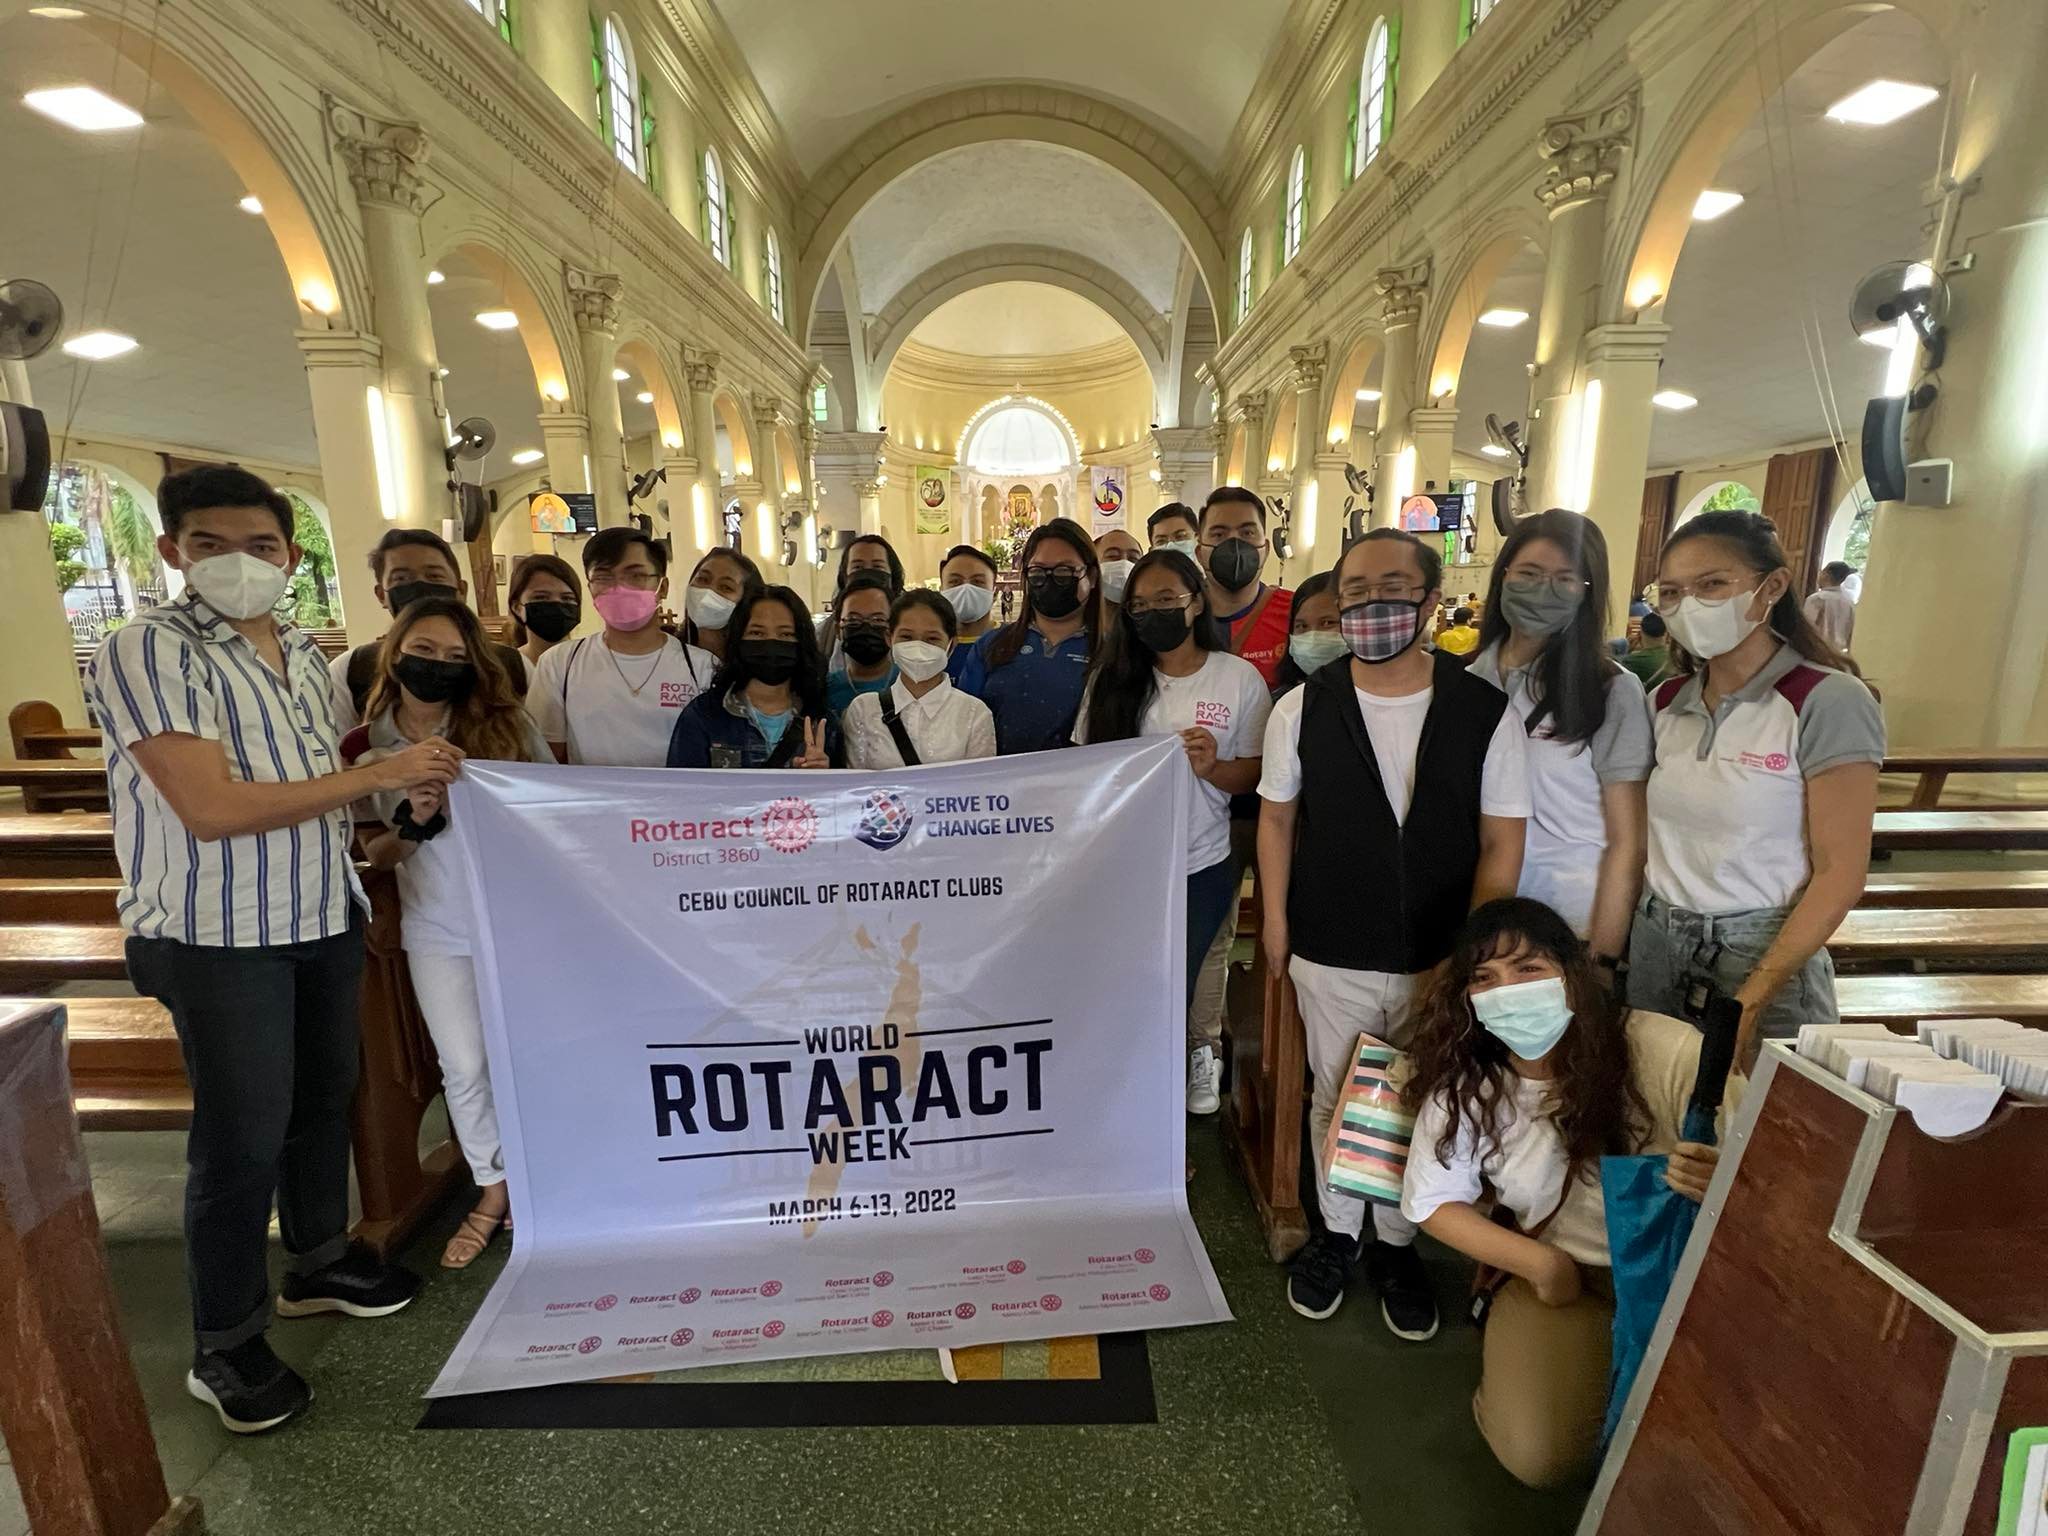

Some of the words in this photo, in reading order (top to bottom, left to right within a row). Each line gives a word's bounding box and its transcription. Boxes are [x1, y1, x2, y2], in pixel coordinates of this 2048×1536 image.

[1242, 650, 1273, 659] Rotary
[660, 682, 695, 693] ROTA
[1197, 701, 1231, 714] ROTA
[1196, 710, 1230, 723] RACT
[925, 796, 980, 814] SERVE
[986, 795, 1009, 811] TO
[631, 816, 754, 843] Rotaract
[927, 819, 1001, 836] CHANGE
[1006, 816, 1054, 834] LIVES
[653, 852, 710, 868] District
[718, 848, 760, 864] 3860
[680, 892, 727, 912] CEBU
[734, 886, 811, 909] COUNCIL
[817, 884, 839, 904] OF
[847, 879, 940, 902] ROTARACT
[947, 877, 1002, 897] CLUBS
[804, 1023, 900, 1054] WORLD
[650, 1038, 1053, 1136] ROTARACT
[808, 1126, 911, 1164] WEEK
[769, 1197, 842, 1225] MARCH
[850, 1193, 898, 1218] 6-13,
[905, 1188, 955, 1213] 2022
[1088, 1255, 1132, 1265] Rotaract
[962, 1264, 1004, 1274] Rotaract
[825, 1277, 870, 1287] Rotaract
[711, 1287, 757, 1297] Rotaract
[1101, 1291, 1147, 1302] Rotaract
[629, 1294, 677, 1304] Rotaract
[545, 1301, 593, 1311] Rotaract
[991, 1300, 1038, 1311] Rotaract
[907, 1309, 952, 1320] Rotaract
[821, 1316, 868, 1328] Rotaract
[712, 1327, 760, 1338] Rotaract
[617, 1335, 668, 1345] Rotaract
[527, 1343, 577, 1353] Rotaract
